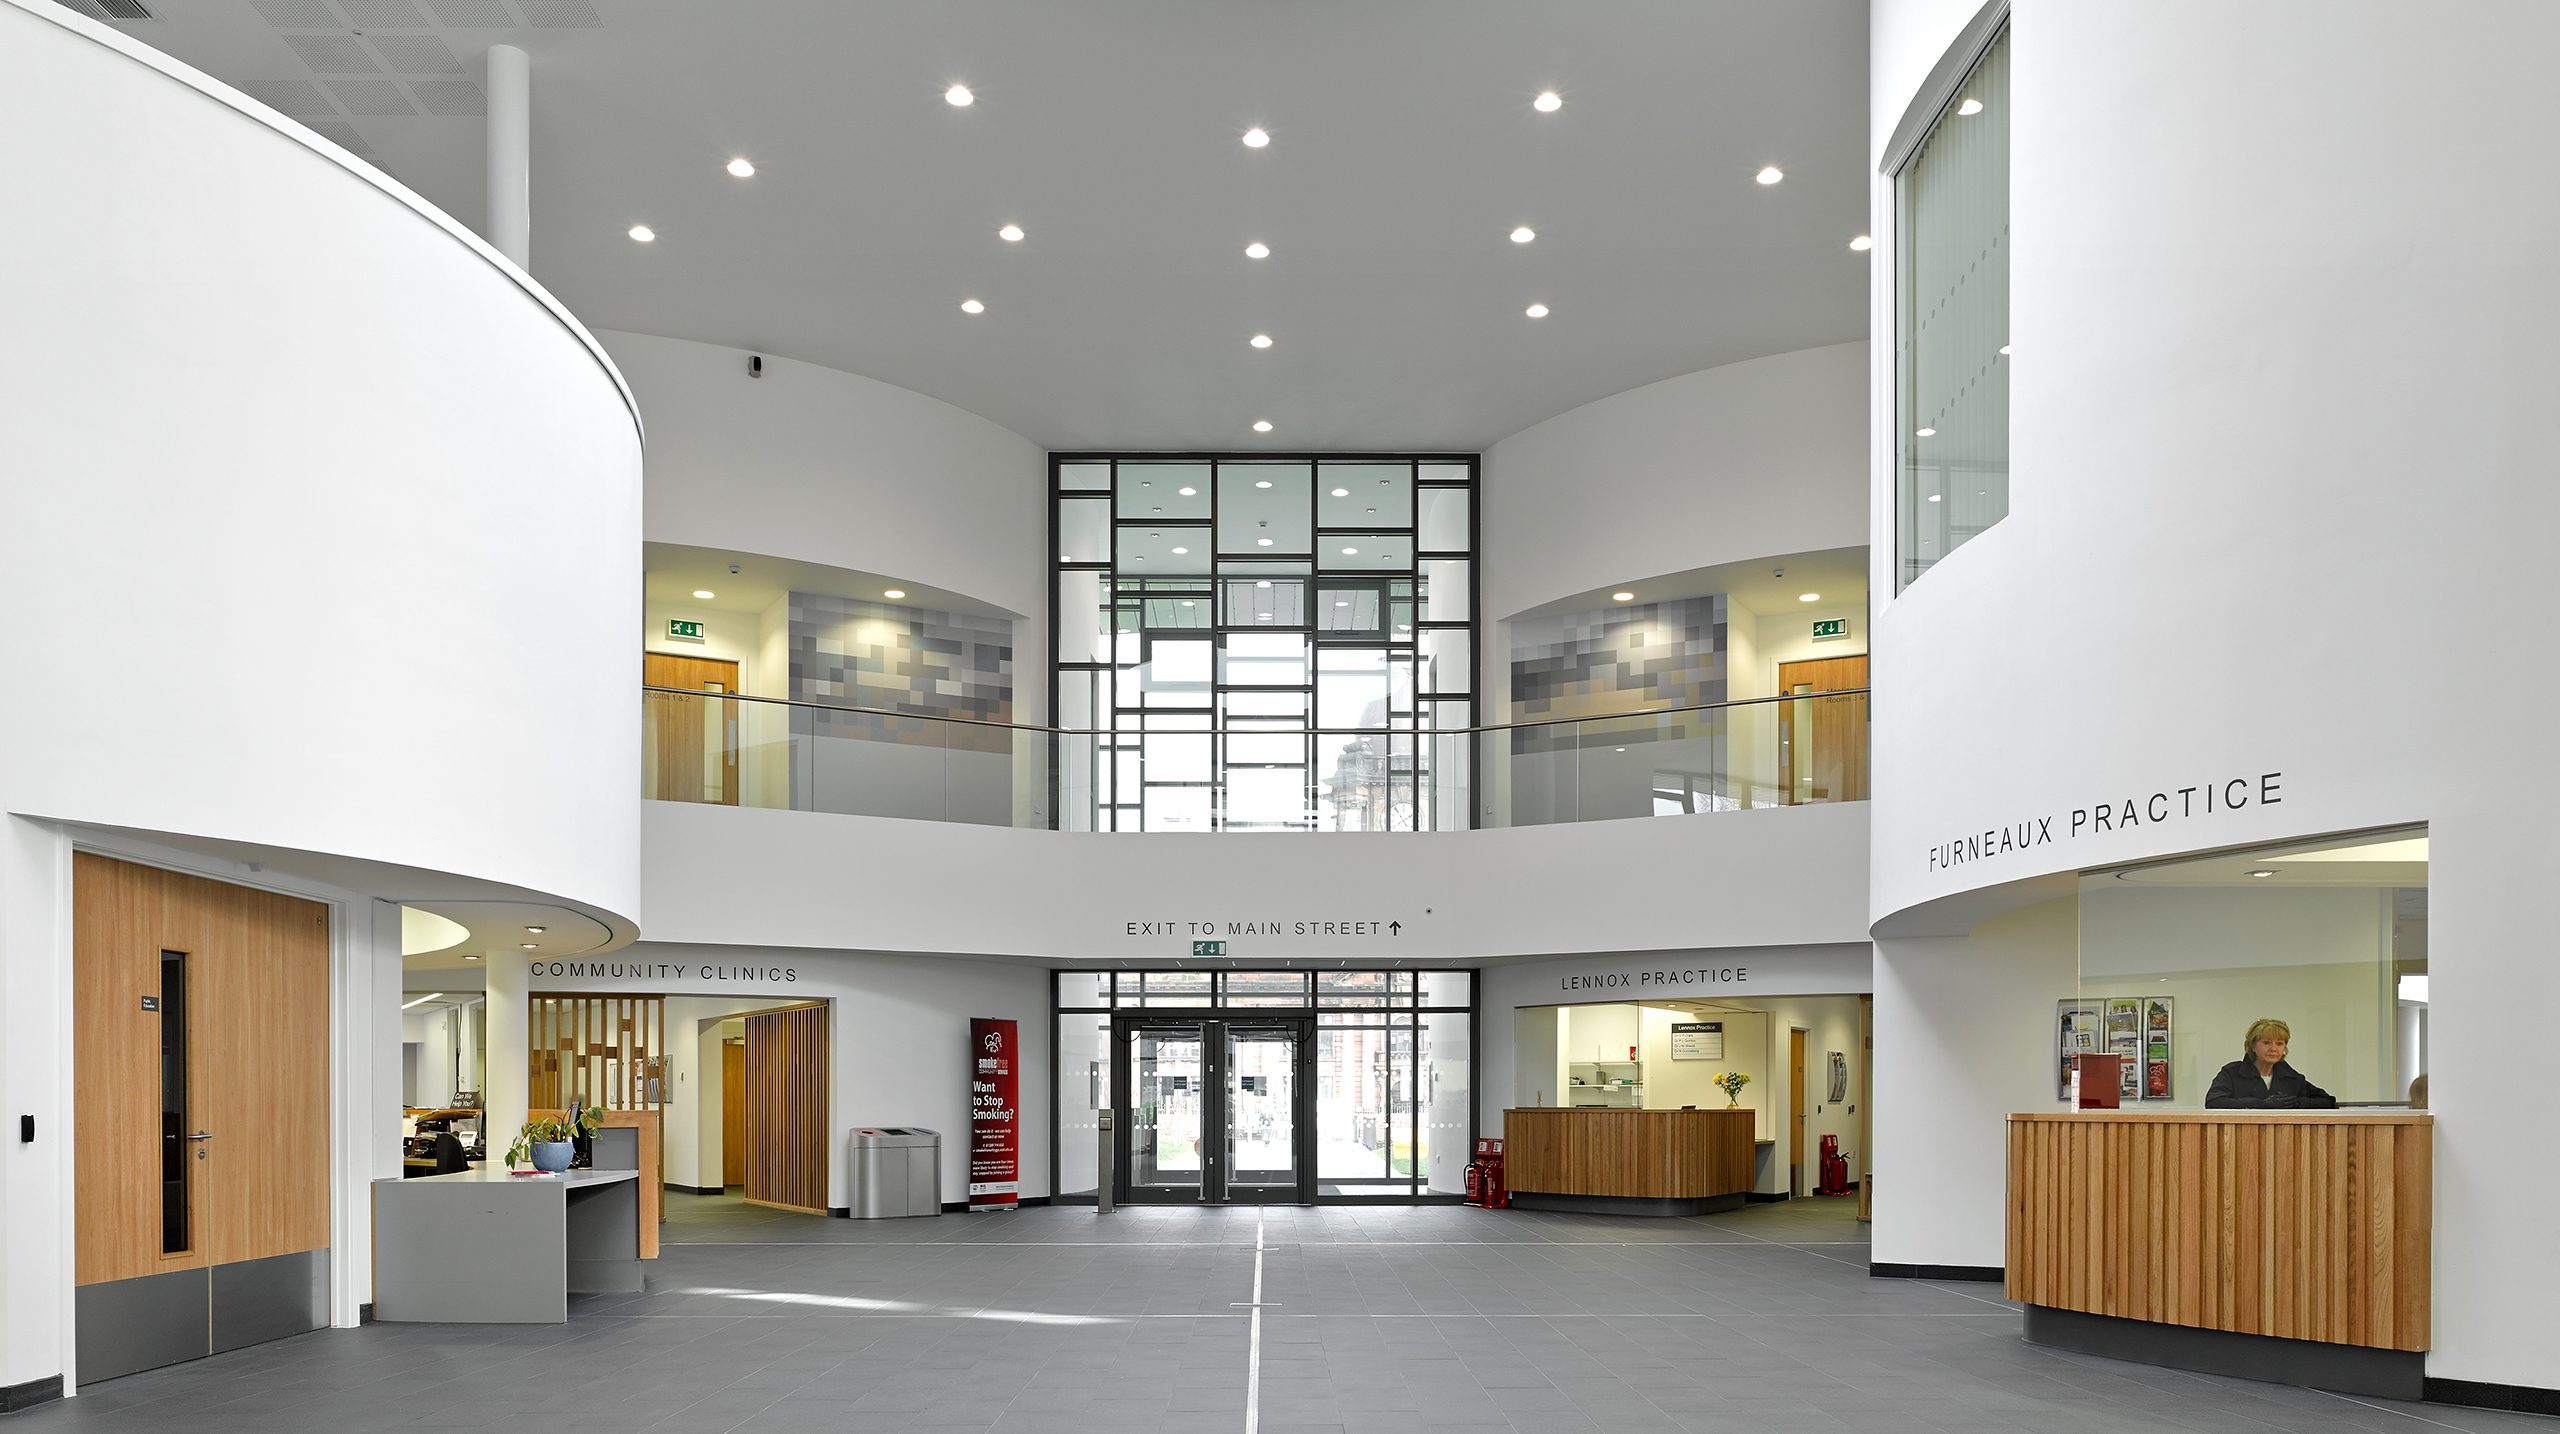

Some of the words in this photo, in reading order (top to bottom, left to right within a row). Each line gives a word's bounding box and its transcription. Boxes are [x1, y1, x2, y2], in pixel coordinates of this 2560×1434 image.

[1929, 816, 2052, 873] FURNEAUX
[2071, 772, 2282, 838] PRACTICE
[1127, 922, 1176, 935] EXIT
[1188, 922, 1215, 935] TO
[1228, 922, 1281, 935] MAIN
[1294, 922, 1380, 935] STREET
[531, 962, 686, 979] COMMUNITY
[700, 966, 797, 982] CLINICS
[1562, 973, 1630, 990] LENNOX
[1641, 968, 1747, 985] PRACTICE
[973, 1081, 996, 1092] Want
[454, 1092, 464, 1100] Can
[973, 1096, 982, 1106] to
[984, 1095, 1004, 1108] Stop
[973, 1108, 1014, 1122] Smoking?
